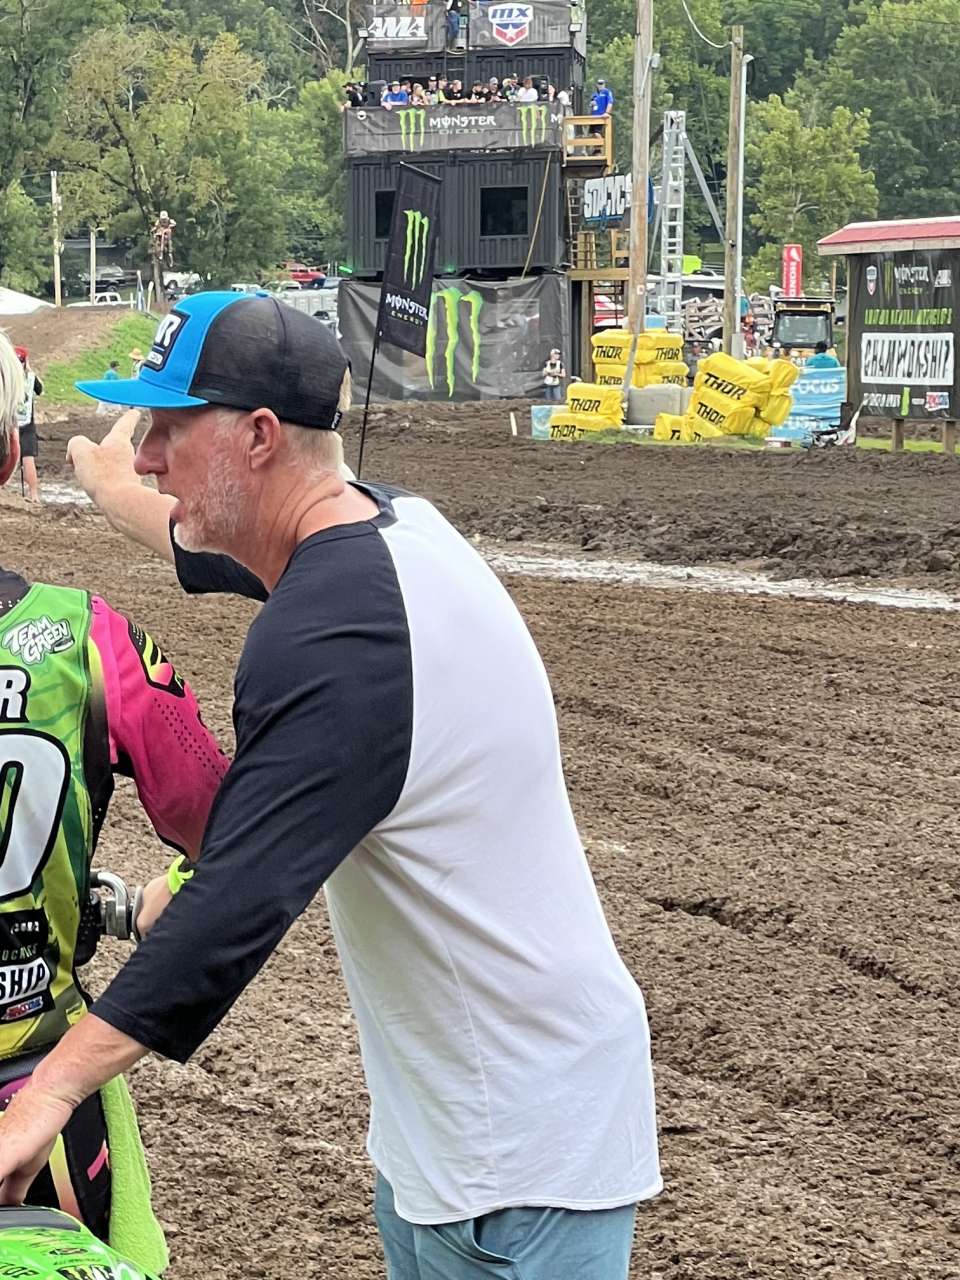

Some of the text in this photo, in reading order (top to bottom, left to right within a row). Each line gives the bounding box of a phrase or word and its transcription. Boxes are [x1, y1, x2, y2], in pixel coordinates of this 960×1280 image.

[369, 17, 426, 37] AMA
[429, 115, 496, 128] MONSTER
[385, 292, 428, 321] MONSTER
[595, 345, 623, 360] THOR
[655, 347, 680, 360] THOR
[703, 372, 749, 401] THOR
[570, 398, 601, 412] THOR
[697, 401, 726, 425] THOR
[551, 424, 577, 438] THOR
[3, 616, 51, 652] TEAM
[22, 620, 71, 664] GREEN
